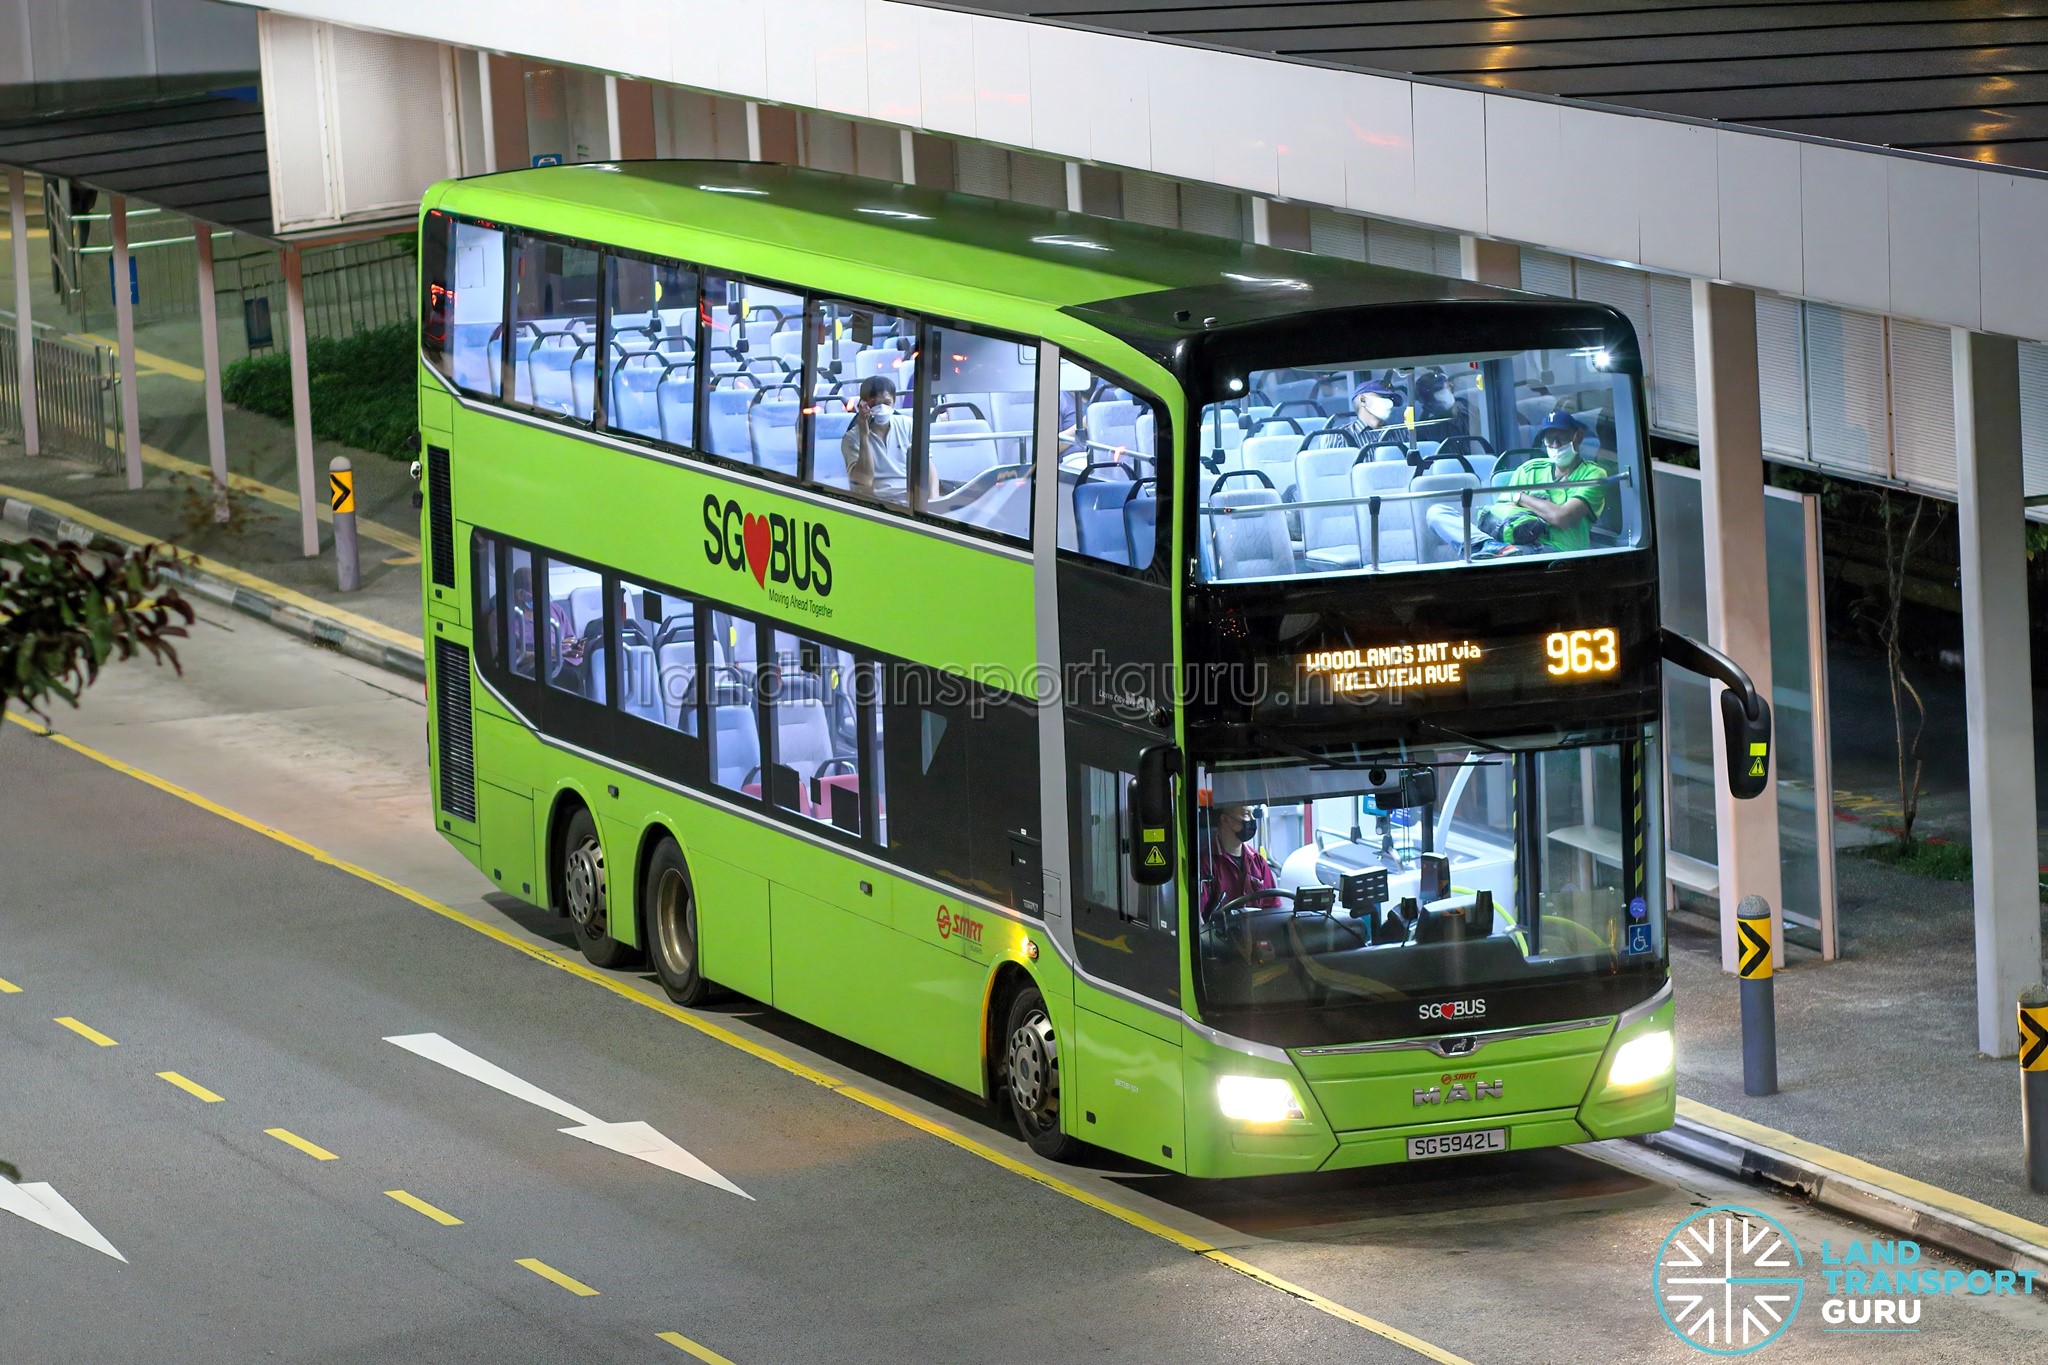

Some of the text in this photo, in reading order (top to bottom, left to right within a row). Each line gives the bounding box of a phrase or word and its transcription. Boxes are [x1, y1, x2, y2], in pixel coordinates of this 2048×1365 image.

[769, 588, 833, 618] Moving Ahead Together
[1306, 640, 1481, 672] WOODLANDS INT via
[1546, 628, 1617, 676] 963
[1333, 663, 1461, 692] HILLVIEW AVE
[952, 912, 984, 942] SMRT
[1413, 1079, 1503, 1107] MAN
[1415, 1132, 1499, 1156] SG5942L
